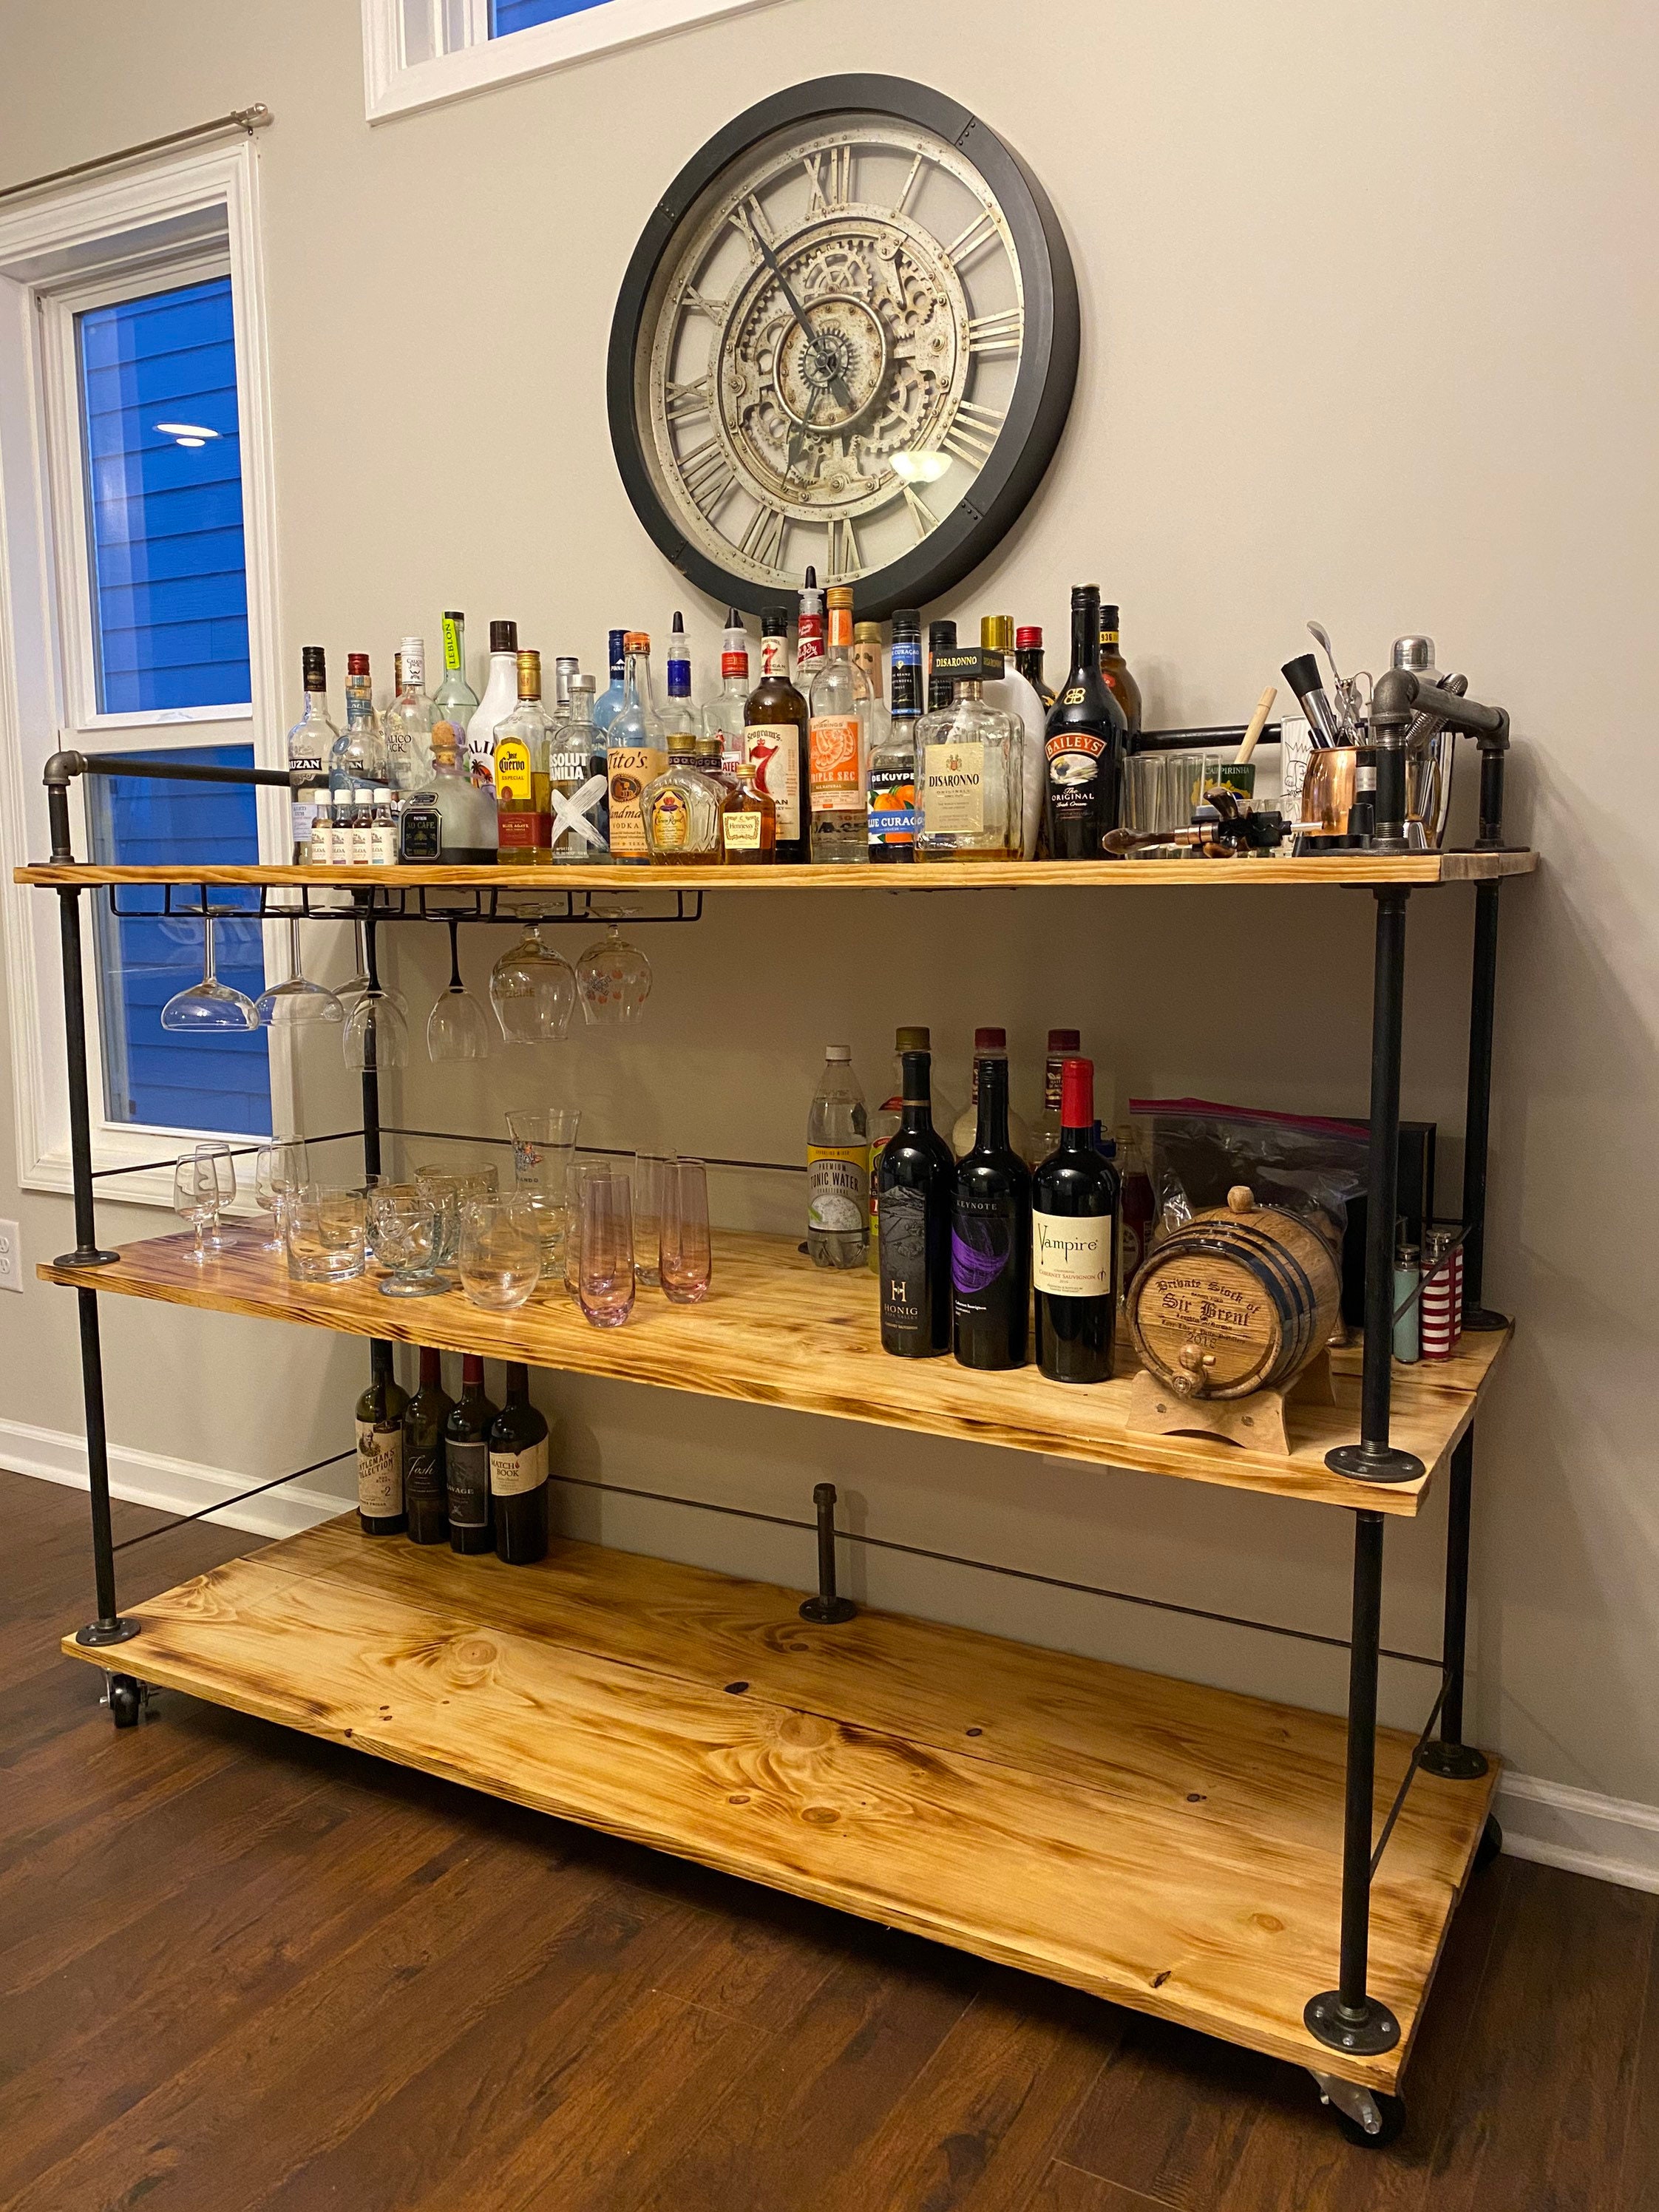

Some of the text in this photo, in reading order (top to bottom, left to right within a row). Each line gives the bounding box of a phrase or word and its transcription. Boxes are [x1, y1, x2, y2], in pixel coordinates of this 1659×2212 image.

[446, 623, 455, 665] LEBLON
[936, 656, 977, 668] DISARONNO
[747, 730, 782, 742] Seagram's
[1047, 736, 1100, 756] BAILEYS
[289, 759, 320, 770] RUZAN
[499, 757, 525, 773] Cuervo
[550, 766, 585, 781] ANILIA
[812, 770, 856, 783] RIPLE SEC
[872, 772, 915, 782] DEKUYPE
[929, 773, 980, 787] DISARONNO
[1051, 793, 1095, 801] ORIGINAL
[868, 818, 879, 828] LUE
[818, 1163, 847, 1172] PREMIUM
[810, 1172, 858, 1192] TONIC WATER
[957, 1199, 997, 1210] KEYNOTE
[1037, 1222, 1098, 1266] Vampire
[891, 1280, 907, 1303] H
[1156, 1278, 1202, 1293] Private
[1207, 1281, 1244, 1303] Stock
[884, 1303, 918, 1315] HONIG
[1162, 1292, 1192, 1313] Sir
[1199, 1300, 1251, 1327] Brent
[407, 1454, 436, 1479] Josh
[491, 1458, 515, 1470] MATCH
[497, 1468, 519, 1477] BOOK
[447, 1483, 475, 1495] AVAGE
